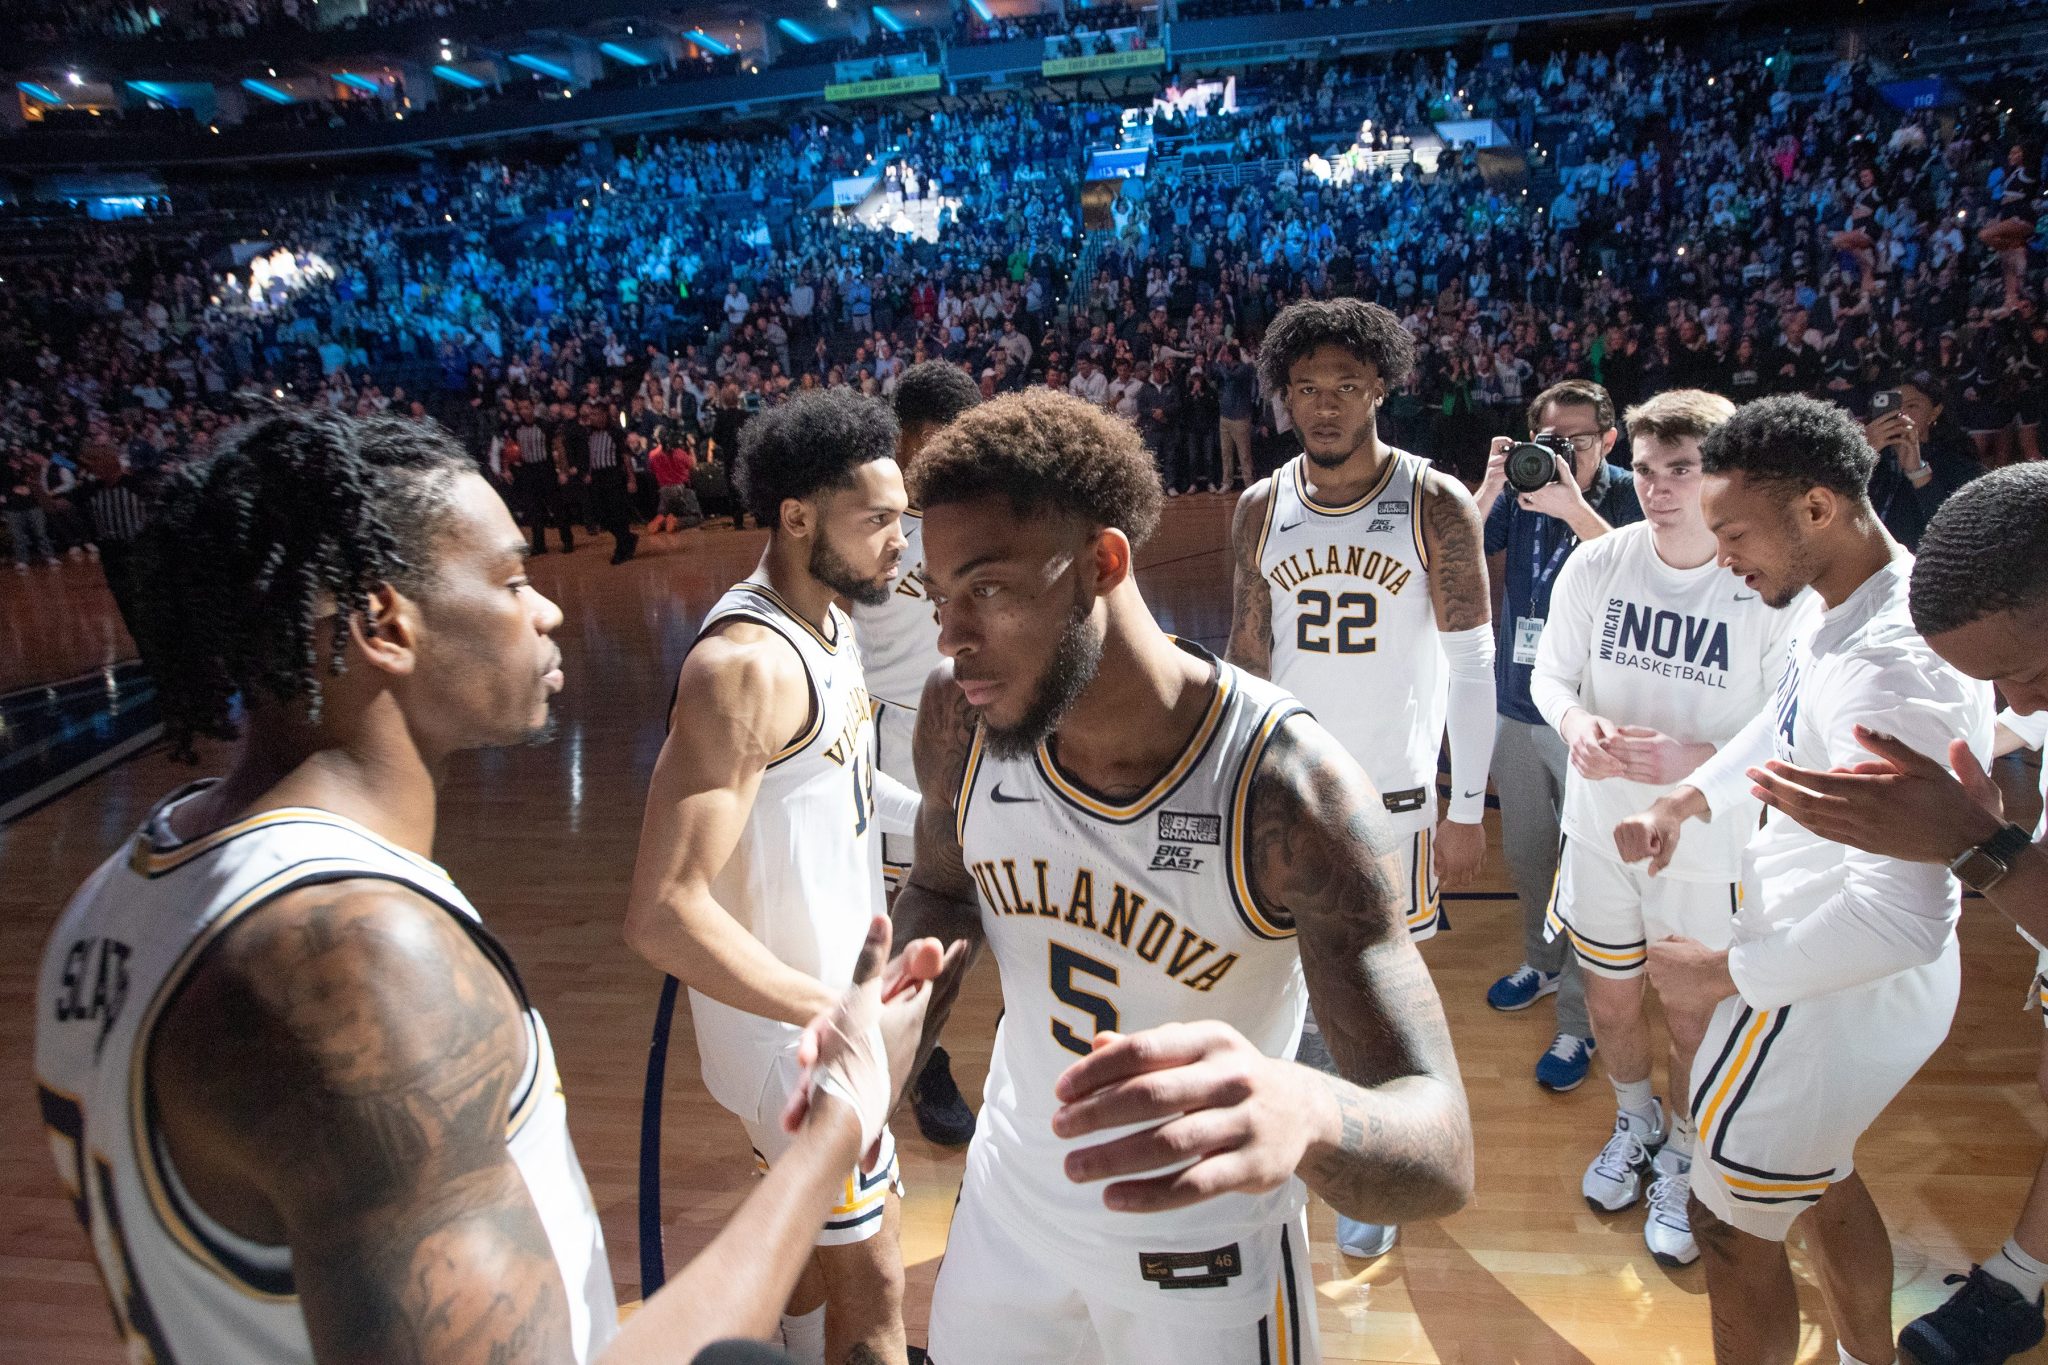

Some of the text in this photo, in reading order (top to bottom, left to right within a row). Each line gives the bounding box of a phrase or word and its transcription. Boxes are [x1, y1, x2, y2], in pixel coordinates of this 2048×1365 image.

[1269, 544, 1412, 596] VILLANOVA
[1297, 589, 1378, 655] 22
[1600, 598, 1624, 660] WILDCATS
[1618, 602, 1728, 671] NOVA
[1615, 651, 1727, 689] BASKETBALL
[1156, 845, 1193, 857] BIG
[1160, 828, 1218, 843] CHANGE
[1150, 855, 1204, 870] EAST
[972, 857, 1241, 992] VILLANOVA
[1048, 938, 1121, 1058] 5
[1215, 1254, 1233, 1267] 46
